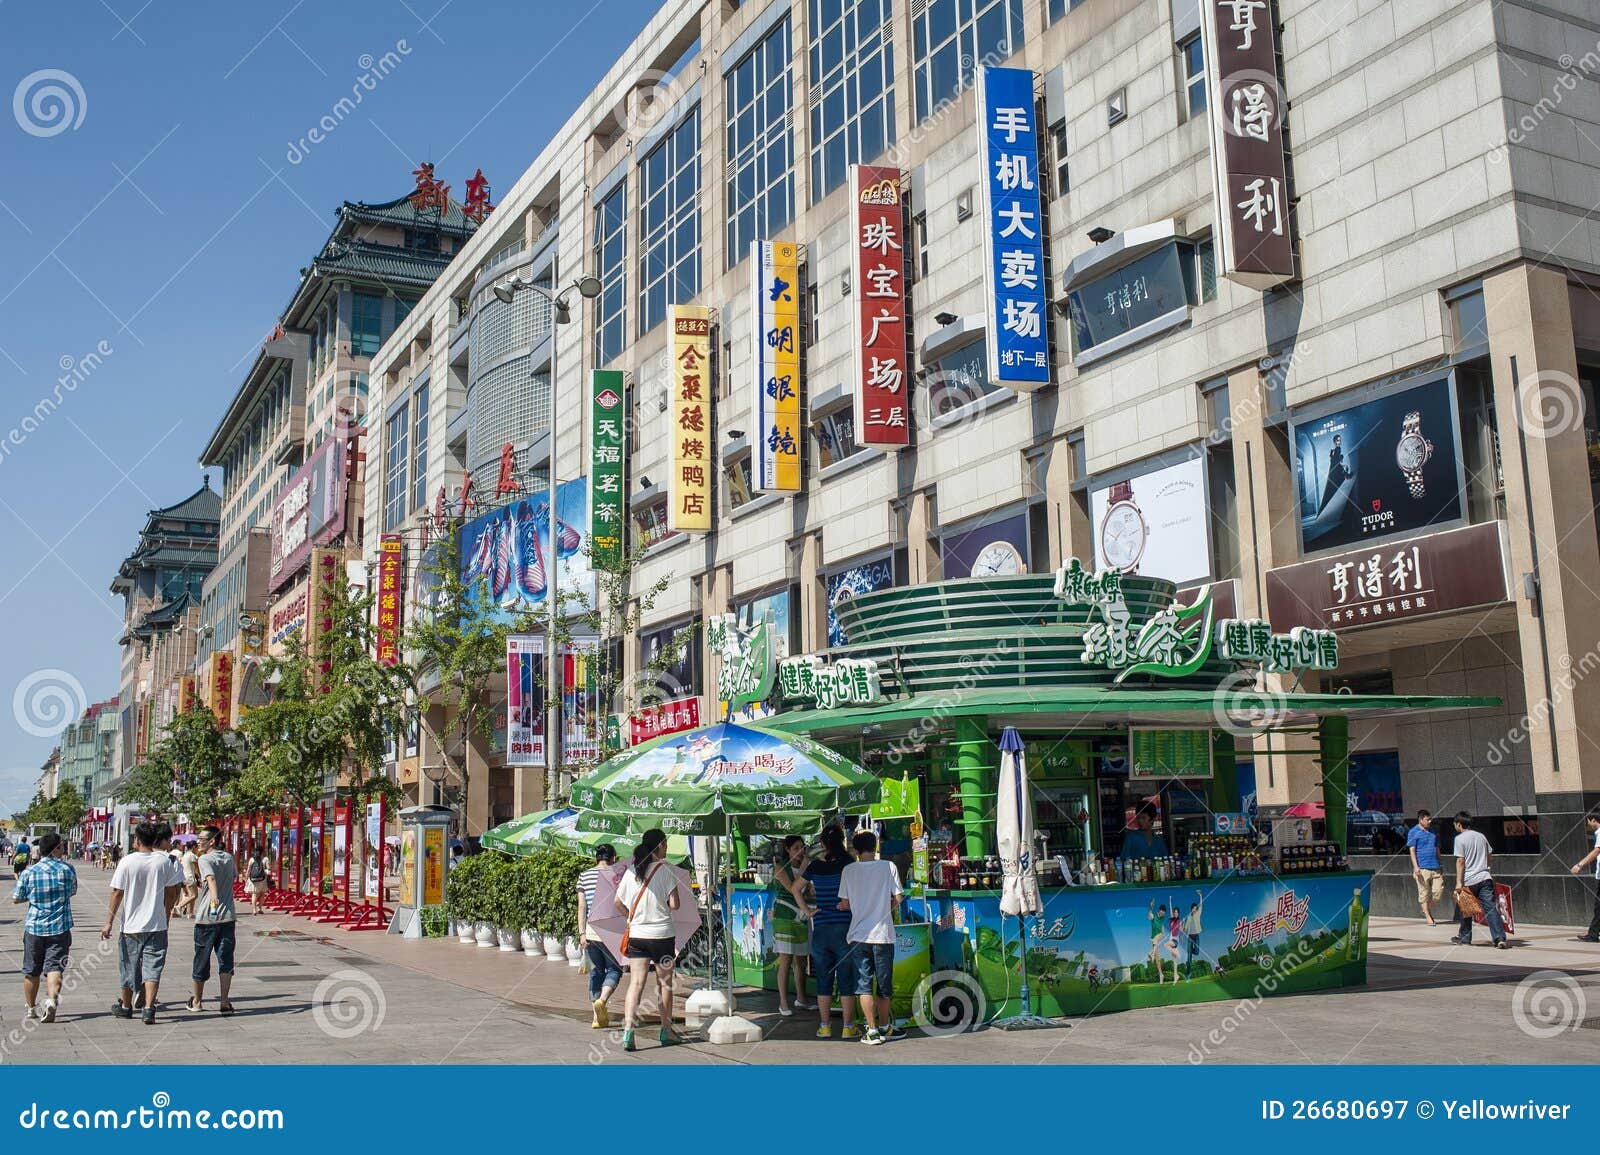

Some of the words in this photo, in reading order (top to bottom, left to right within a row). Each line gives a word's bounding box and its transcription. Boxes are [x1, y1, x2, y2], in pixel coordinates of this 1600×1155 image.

[992, 107, 1041, 338] 手机大卖场
[861, 216, 903, 394] 珠宝广场
[1001, 350, 1046, 369] 地下一层
[679, 344, 705, 514] 全聚德烤鸭店
[866, 406, 905, 427] 三层
[594, 419, 621, 524] 天福茗茶
[1362, 511, 1394, 525] TUDOR
[1327, 546, 1422, 603] 亨得利
[1223, 618, 1339, 672] 健康好心情
[780, 659, 871, 711] 健康好心情
[708, 753, 796, 782] 为青春喝彩
[1232, 889, 1310, 952] 为青春喝彩
